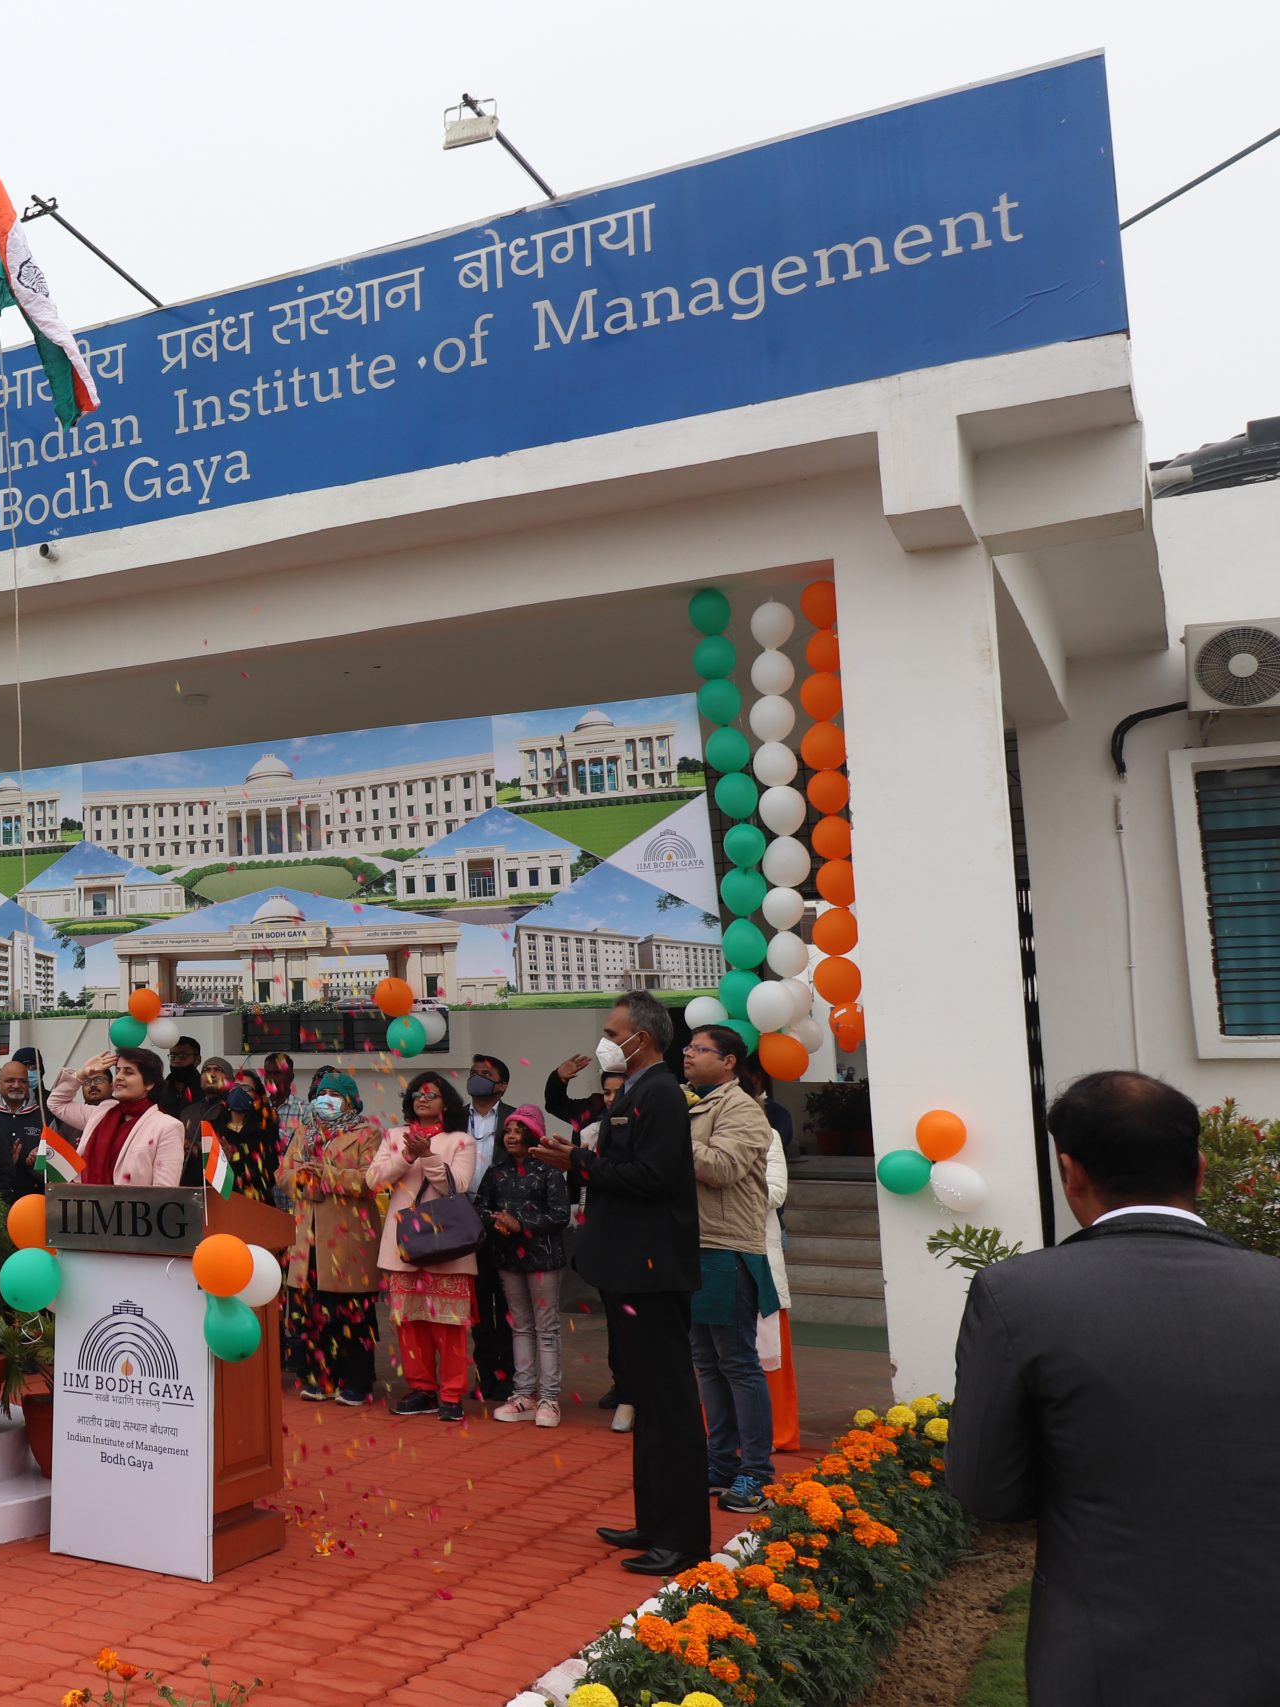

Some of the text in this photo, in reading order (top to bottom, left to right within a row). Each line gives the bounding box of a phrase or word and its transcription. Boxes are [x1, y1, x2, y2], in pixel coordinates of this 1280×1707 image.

[157, 309, 253, 374] प्रबंध
[268, 286, 425, 345] संस्थान
[453, 203, 656, 293] बोधगया
[173, 352, 397, 435] Institute
[432, 313, 494, 374] of
[532, 192, 1024, 351] Management
[123, 449, 251, 505] Gaya
[653, 861, 678, 869] BODH
[680, 859, 705, 867] GAYA
[265, 931, 286, 939] BODH
[57, 1198, 189, 1240] IIMBG
[63, 1372, 195, 1401] IIM BODH GAYA
[76, 1414, 179, 1438] भारतीय प्रबंध संस्थान बोधगया
[66, 1431, 189, 1457] Indian Institute of Management
[100, 1451, 154, 1472] Bodh Gaya
